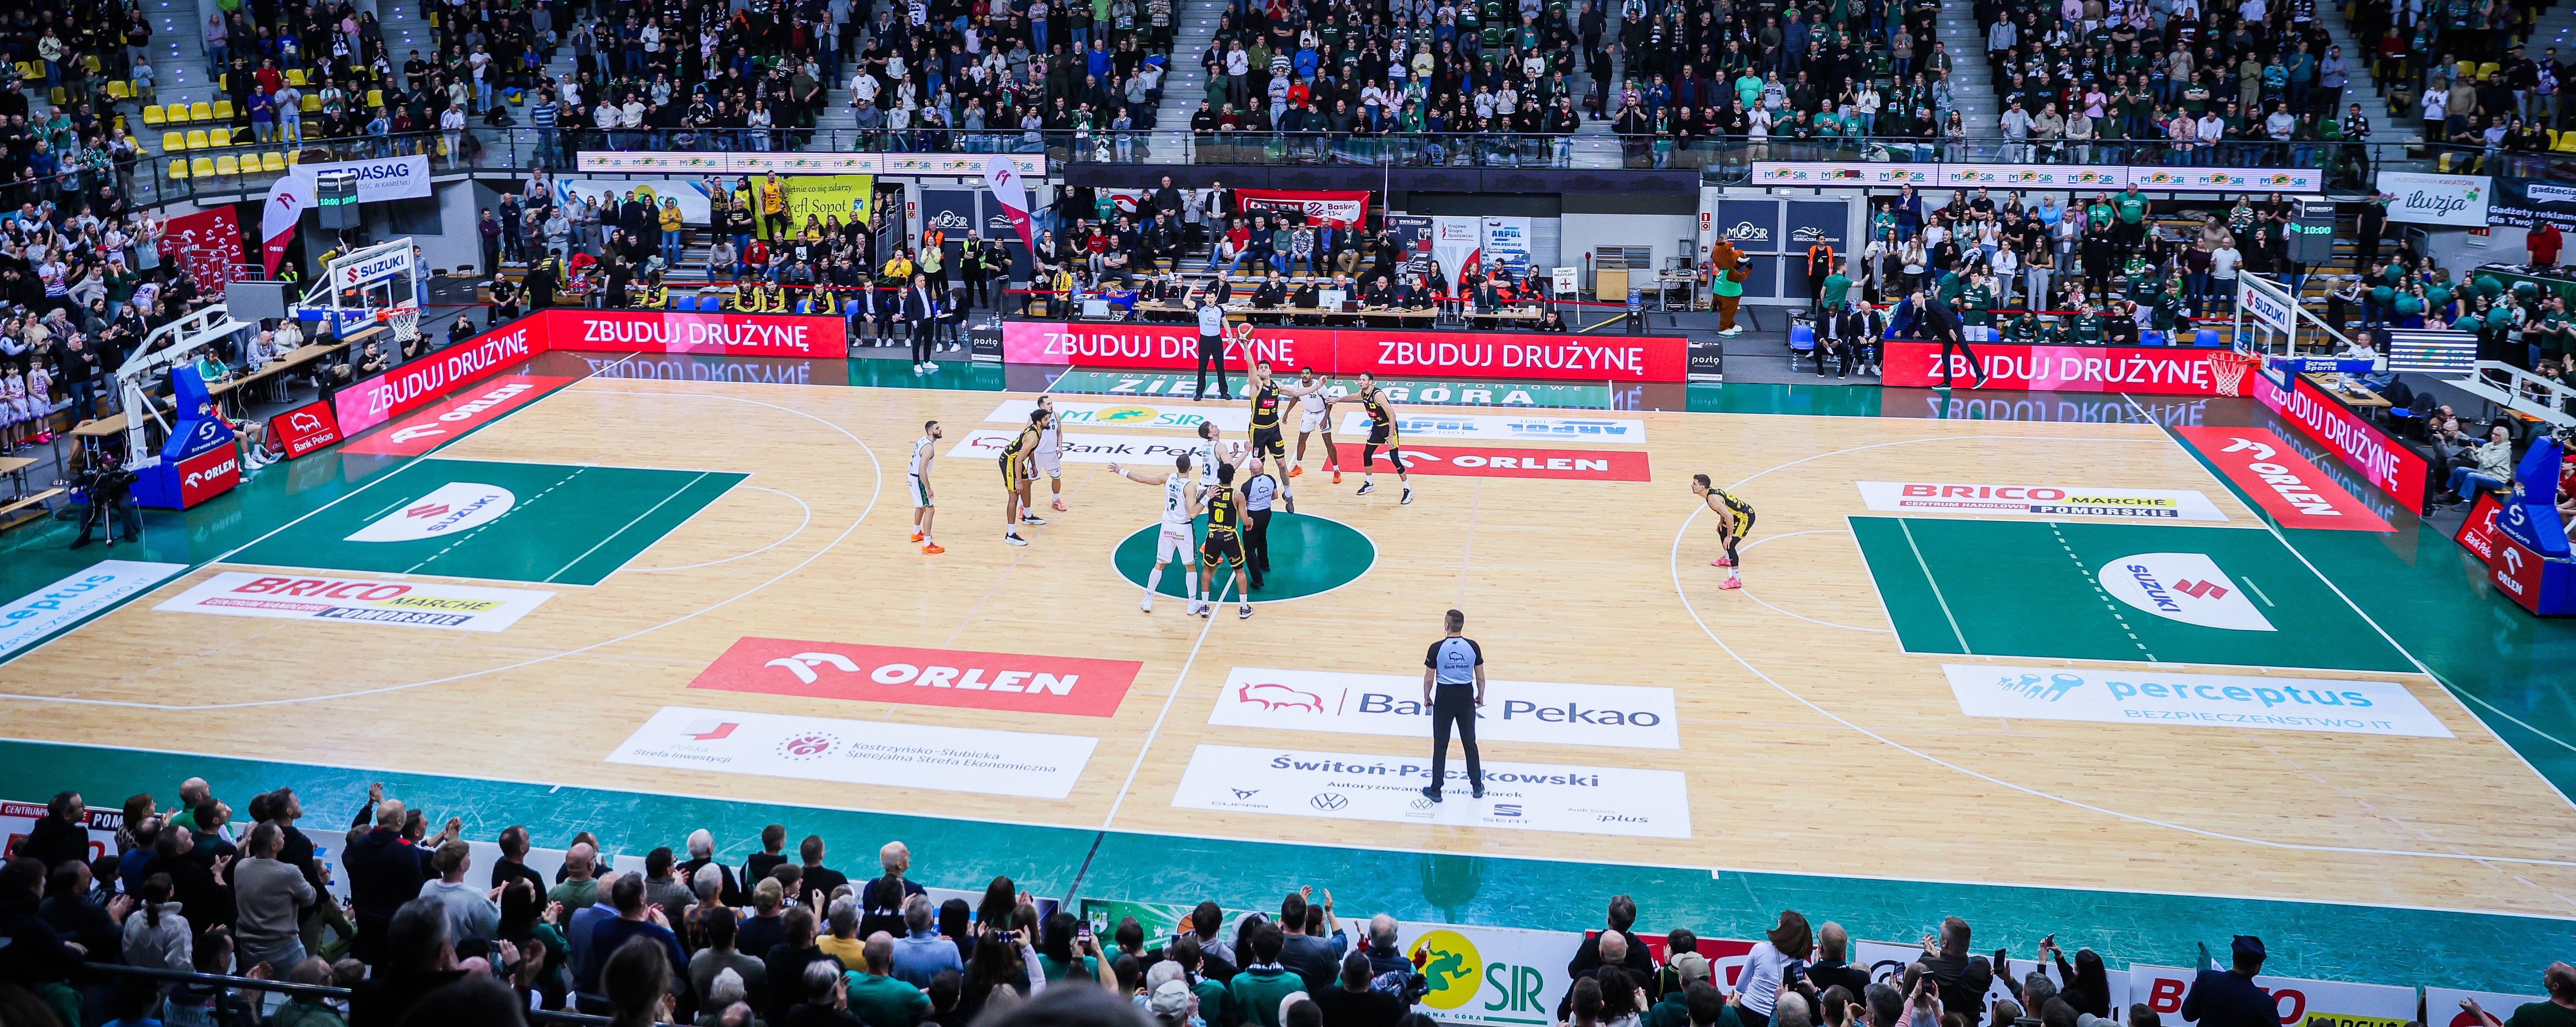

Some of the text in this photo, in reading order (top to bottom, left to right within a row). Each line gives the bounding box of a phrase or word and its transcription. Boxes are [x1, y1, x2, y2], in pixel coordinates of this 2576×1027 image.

[347, 163, 409, 181] DASAG
[381, 179, 411, 188] KAMIENIU
[817, 185, 827, 193] się
[829, 182, 853, 193] zdarzy
[342, 195, 357, 205] 10:00
[812, 198, 847, 215] Sopot
[1250, 201, 1299, 212] ORLEN
[2405, 190, 2468, 217] iluzja
[2488, 215, 2505, 224] dla
[2489, 205, 2533, 218] Gadżety
[2303, 226, 2331, 234] 10:00
[361, 254, 404, 277] SUZUKI
[2255, 296, 2286, 326] SUZUKI
[583, 319, 810, 352] ZBUDUJ DRUŻYNĘ
[974, 337, 998, 347] posto
[1043, 333, 1150, 358] ZBUDUJ
[1378, 340, 1643, 375] ZBUDUJ DRUŻYNĘ
[1692, 355, 1720, 366] posto
[367, 364, 444, 416] ZBUDUJ
[448, 328, 529, 381] DRUŻYNĘ
[1927, 354, 2209, 389] ZBUDUJ DRUŻYNĘ
[439, 383, 535, 422] ORLEN
[1382, 383, 1535, 404] GÓRA
[1506, 423, 1627, 434] ARPOL
[210, 435, 225, 446] Sports
[294, 432, 334, 452] Bank Pekao
[1060, 442, 1134, 455] Bank
[2270, 386, 2324, 431] ZBUDUJ
[2325, 410, 2400, 492] DRUŻYNĘ
[204, 457, 236, 482] ORLEN
[1452, 456, 1608, 471] ORLEN
[1902, 484, 2166, 506] BRICO MARCHÉ
[2248, 462, 2342, 516] ORLEN
[427, 495, 501, 531] SUZUKI
[1962, 502, 2029, 510] HANDLOWE
[2041, 506, 2171, 517] POMORSKIE
[2464, 531, 2479, 548] Bank
[2127, 564, 2182, 613] SUZUKI
[2497, 570, 2523, 595] ORLEN
[230, 577, 493, 611] BRICO MARCHÉ
[203, 597, 467, 626] CENTRUM HANDLOWE POMORSKIE
[870, 662, 1080, 696] ORLEN
[2105, 679, 2374, 709] perceptus
[1503, 699, 1661, 728] Pekao
[2125, 708, 2393, 730] BEZPIECZEŃSTWO IT
[632, 748, 733, 764] Strefa Inwestycji
[670, 742, 709, 753] Polska
[852, 741, 1001, 760] Kostrzyńsko-Słubicka
[844, 748, 1057, 774] Specjalna Strefa Ekonomiczna
[1326, 781, 1425, 793] Autoryzowany
[5, 805, 45, 816] CENTRUM
[1454, 1012, 1481, 1020] GÓRA
